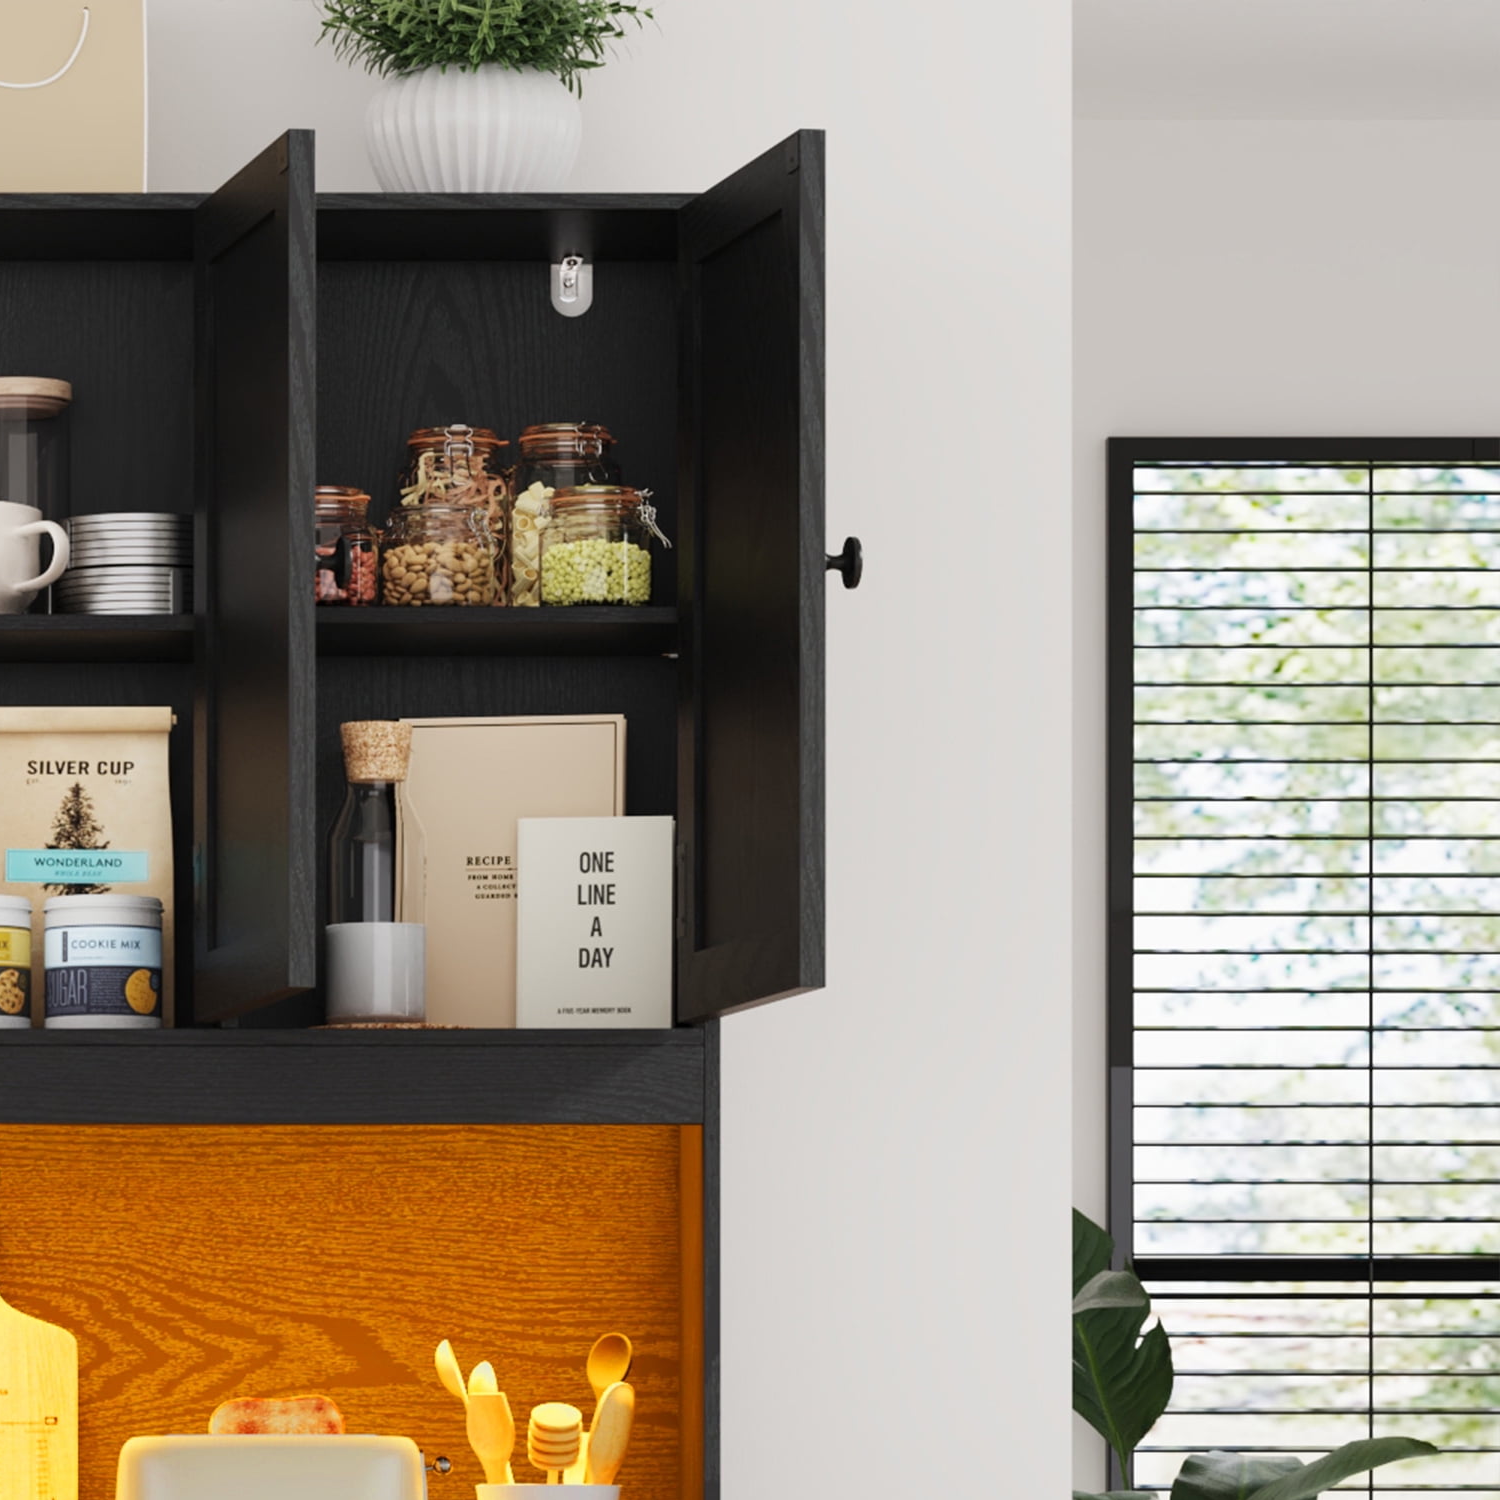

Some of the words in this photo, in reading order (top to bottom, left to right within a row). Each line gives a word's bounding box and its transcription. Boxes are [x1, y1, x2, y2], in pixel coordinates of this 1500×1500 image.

[27, 760, 90, 775] SILVER
[97, 761, 135, 775] CUP
[34, 857, 123, 868] WONDERLAND
[466, 855, 511, 866] RECIPE
[579, 851, 615, 873] ONE
[577, 884, 616, 906] LINE
[590, 916, 602, 937] A
[71, 940, 117, 949] COOKIE
[120, 940, 141, 950] MIX
[578, 947, 614, 968] DAY
